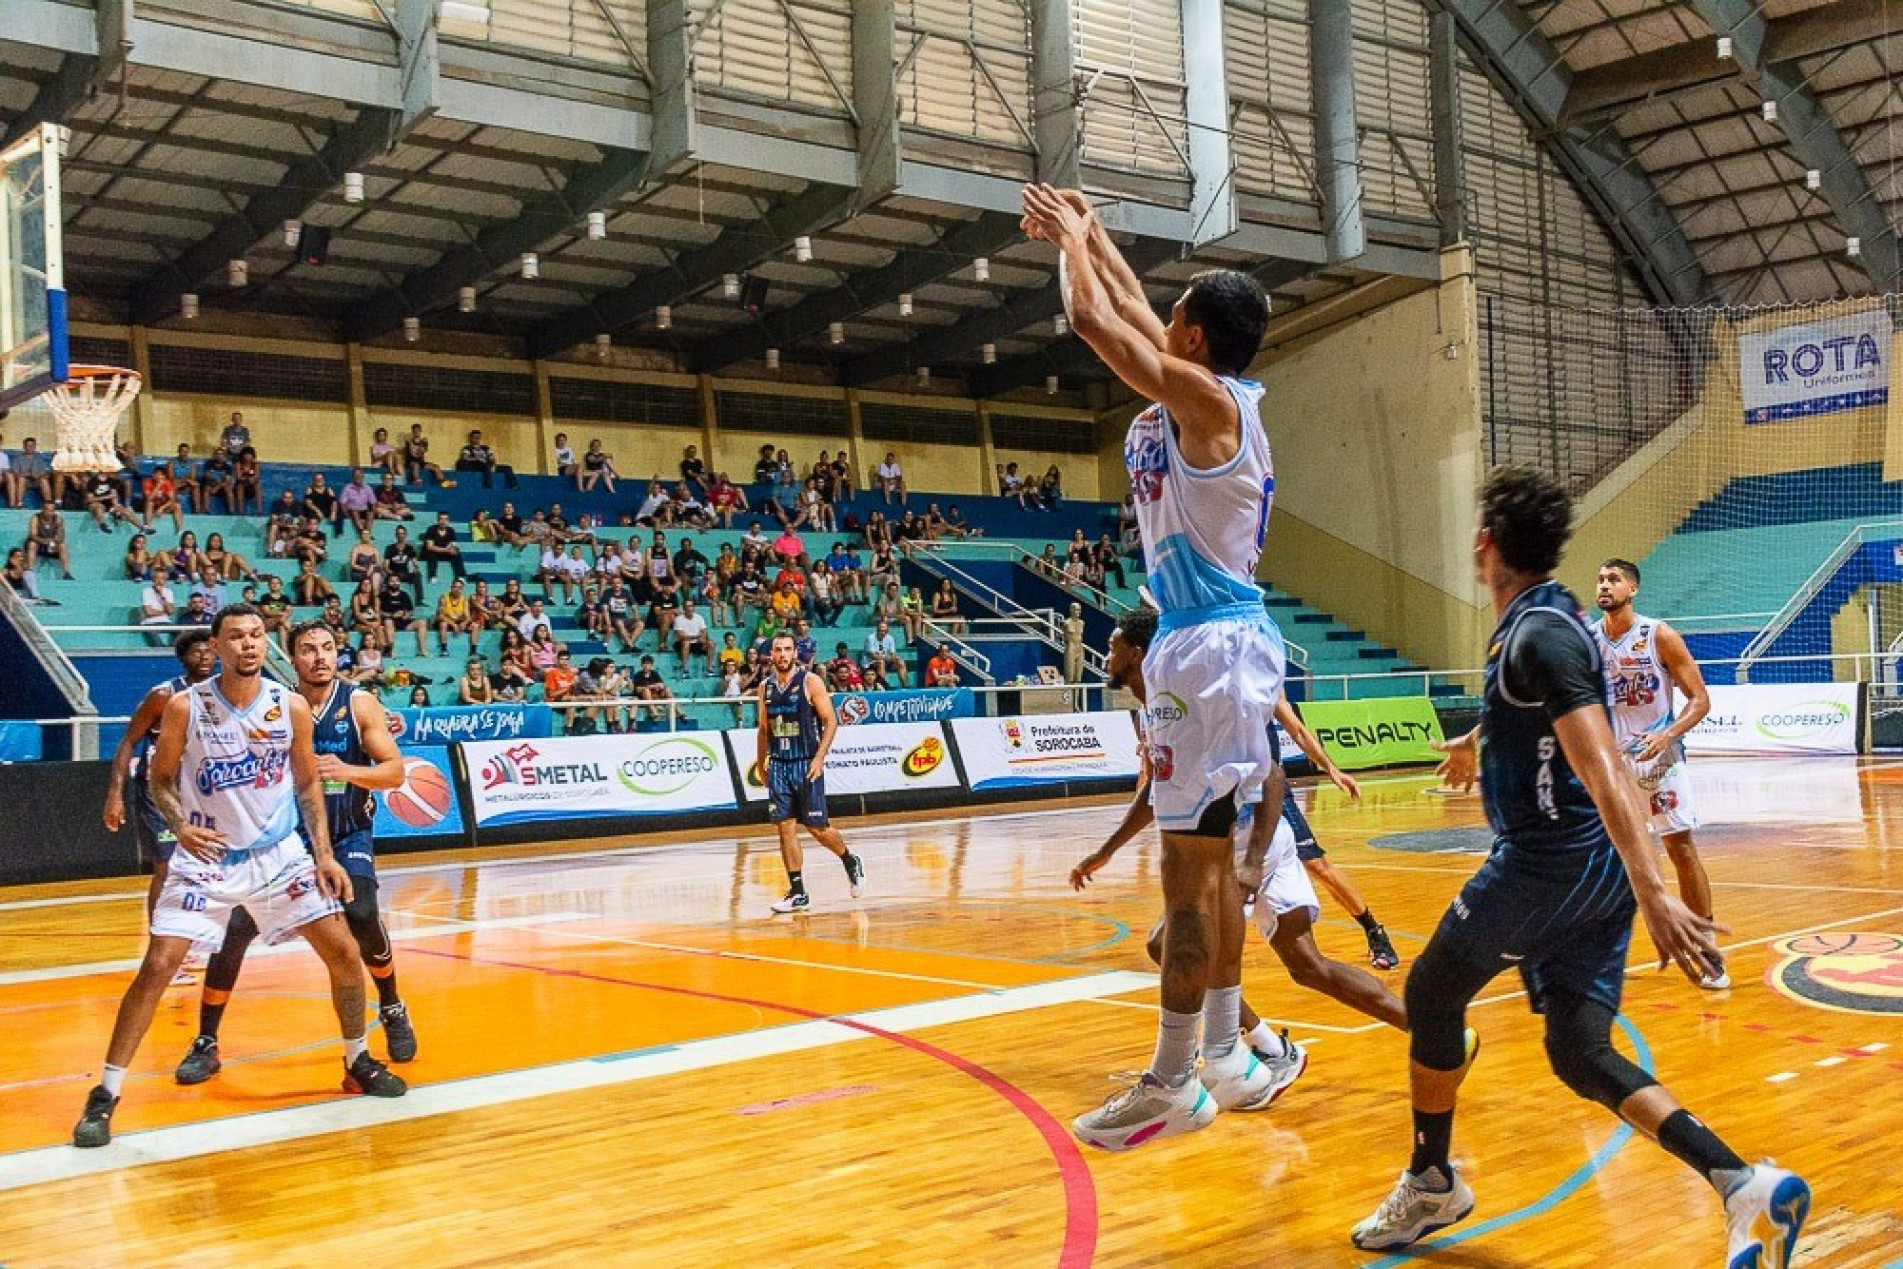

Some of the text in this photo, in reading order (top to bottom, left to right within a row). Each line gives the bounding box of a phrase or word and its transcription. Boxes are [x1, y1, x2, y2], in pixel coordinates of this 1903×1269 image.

[1764, 333, 1880, 384] ROTA
[1761, 712, 1845, 726] COOPERESO
[1315, 721, 1431, 748] PENALTY
[1035, 738, 1102, 752] SOROCABA
[623, 757, 713, 777] COOPERESO
